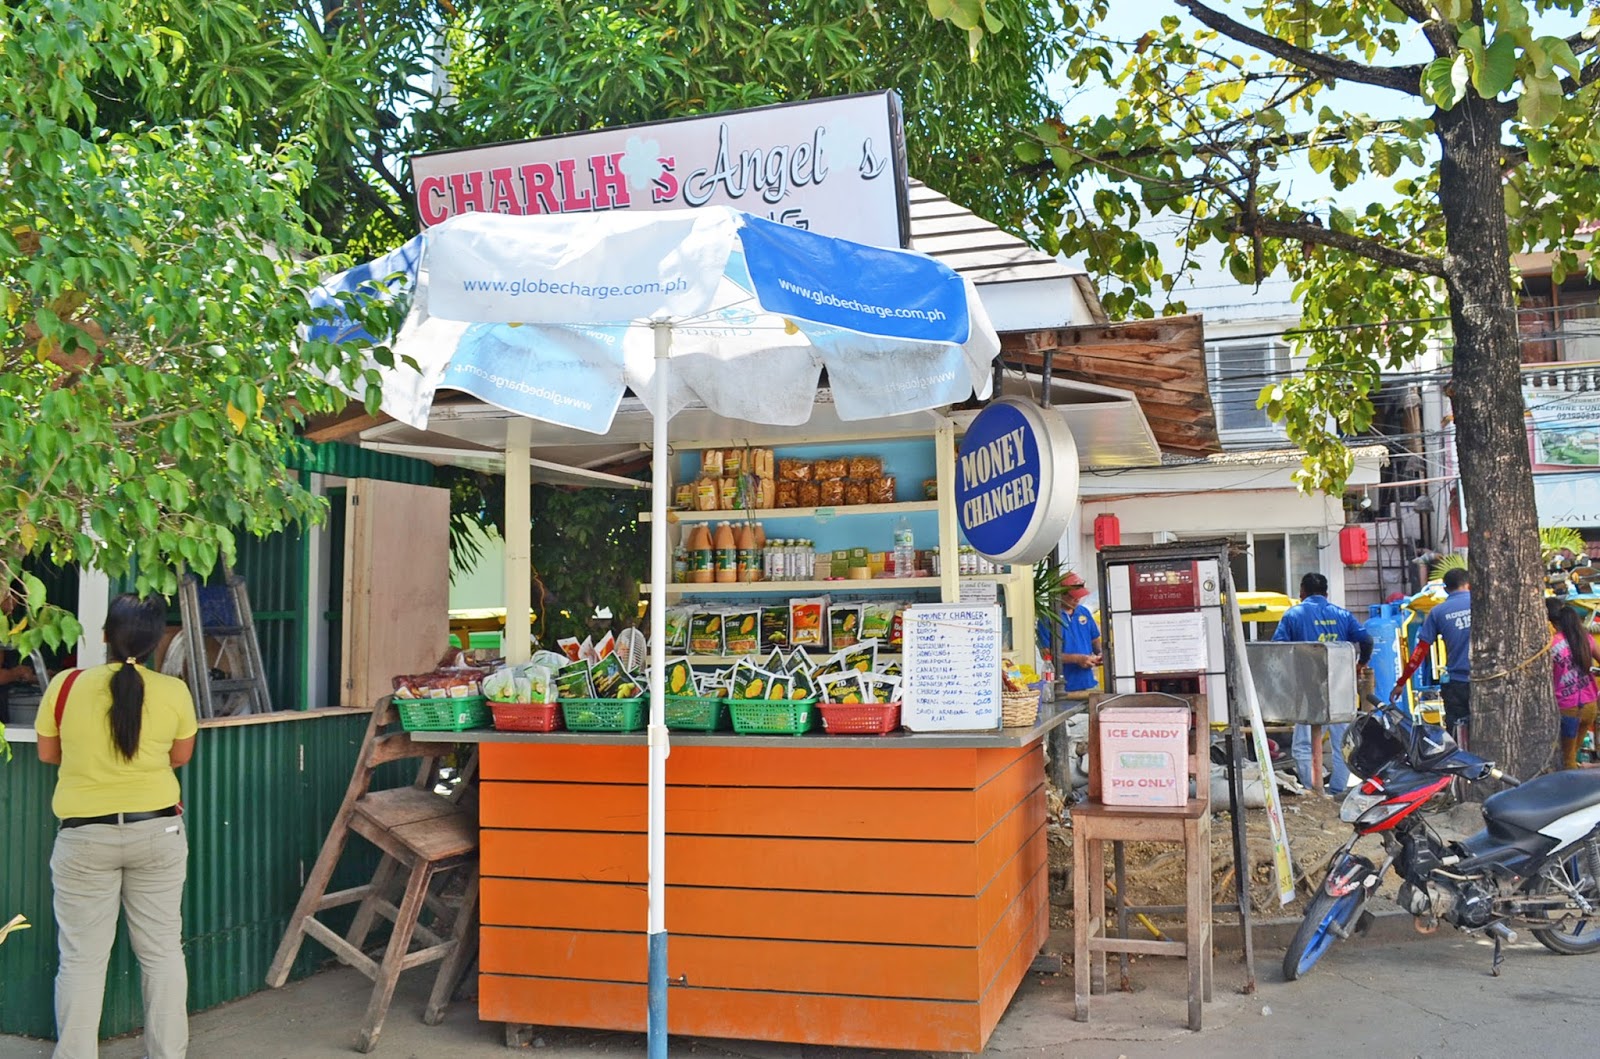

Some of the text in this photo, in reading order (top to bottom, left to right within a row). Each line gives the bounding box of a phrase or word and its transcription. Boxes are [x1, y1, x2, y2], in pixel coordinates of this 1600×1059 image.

[463, 277, 688, 300] www.globecharge.com.ph
[778, 277, 947, 323] www.globecharge.com.ph
[961, 425, 1026, 492] MONEY
[963, 473, 1036, 531] CHANGER
[1108, 729, 1179, 739] ICE CANDY
[1137, 778, 1176, 788] ONLY
